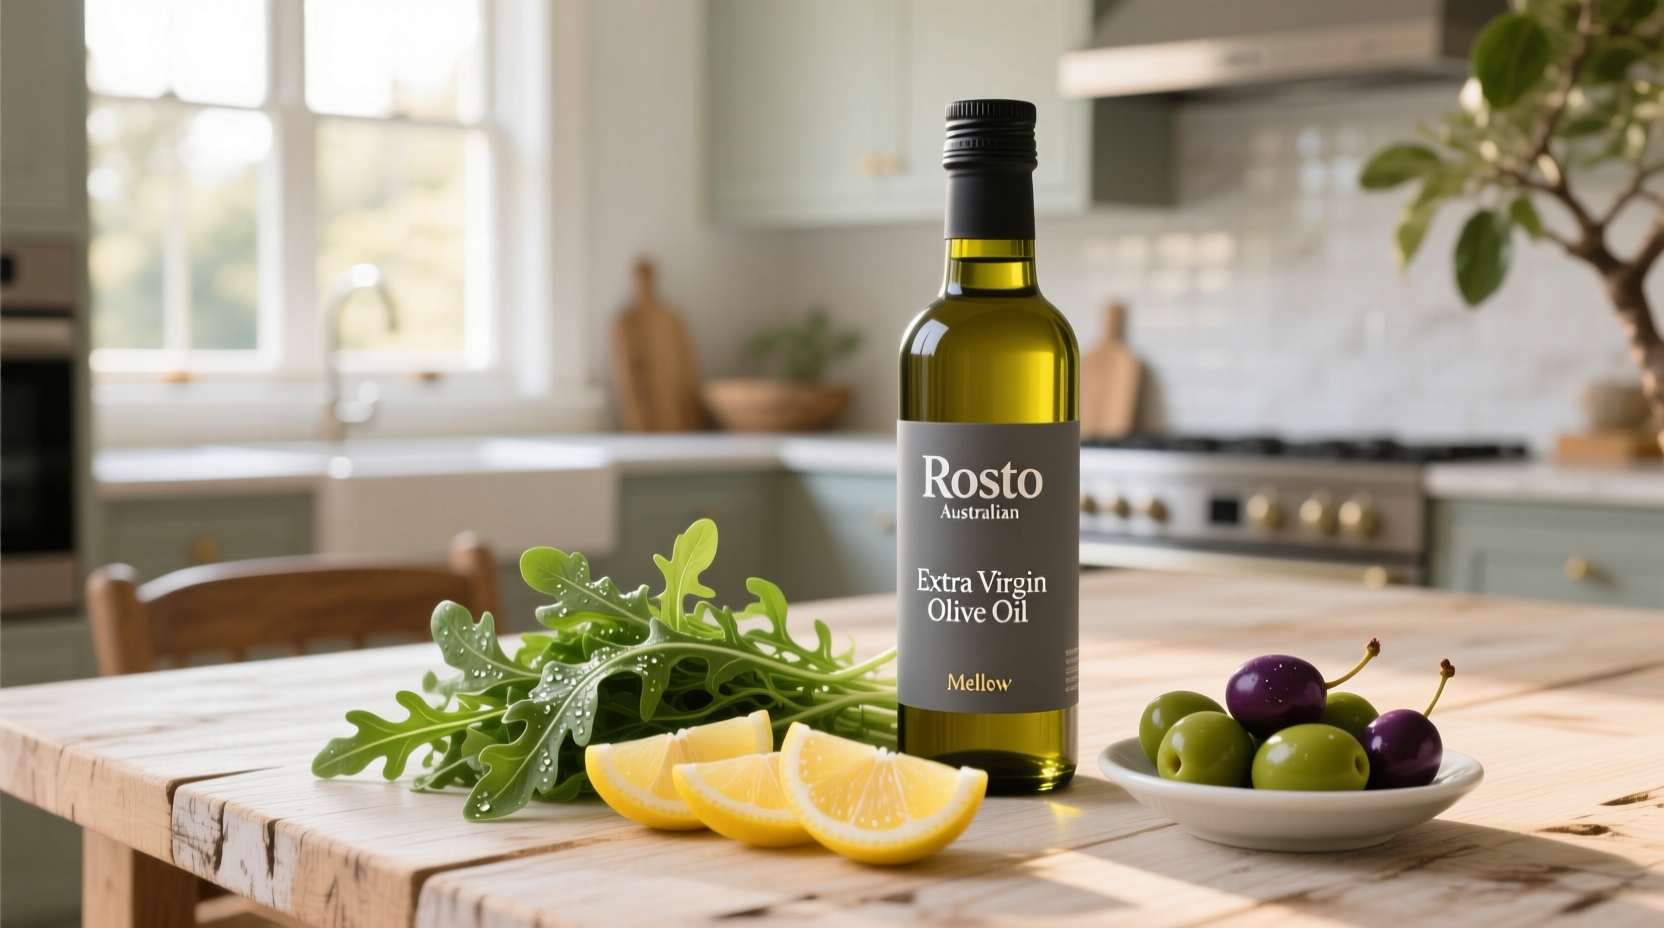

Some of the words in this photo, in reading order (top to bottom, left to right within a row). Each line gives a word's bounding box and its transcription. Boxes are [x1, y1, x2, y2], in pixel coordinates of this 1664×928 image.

[922, 455, 1043, 499] Rosto
[940, 504, 1019, 519] Australian
[917, 568, 973, 593] Extra
[977, 570, 1047, 600] Virgin
[928, 598, 986, 623] Olive
[992, 599, 1028, 623] Oil
[947, 673, 1012, 692] Mellow
